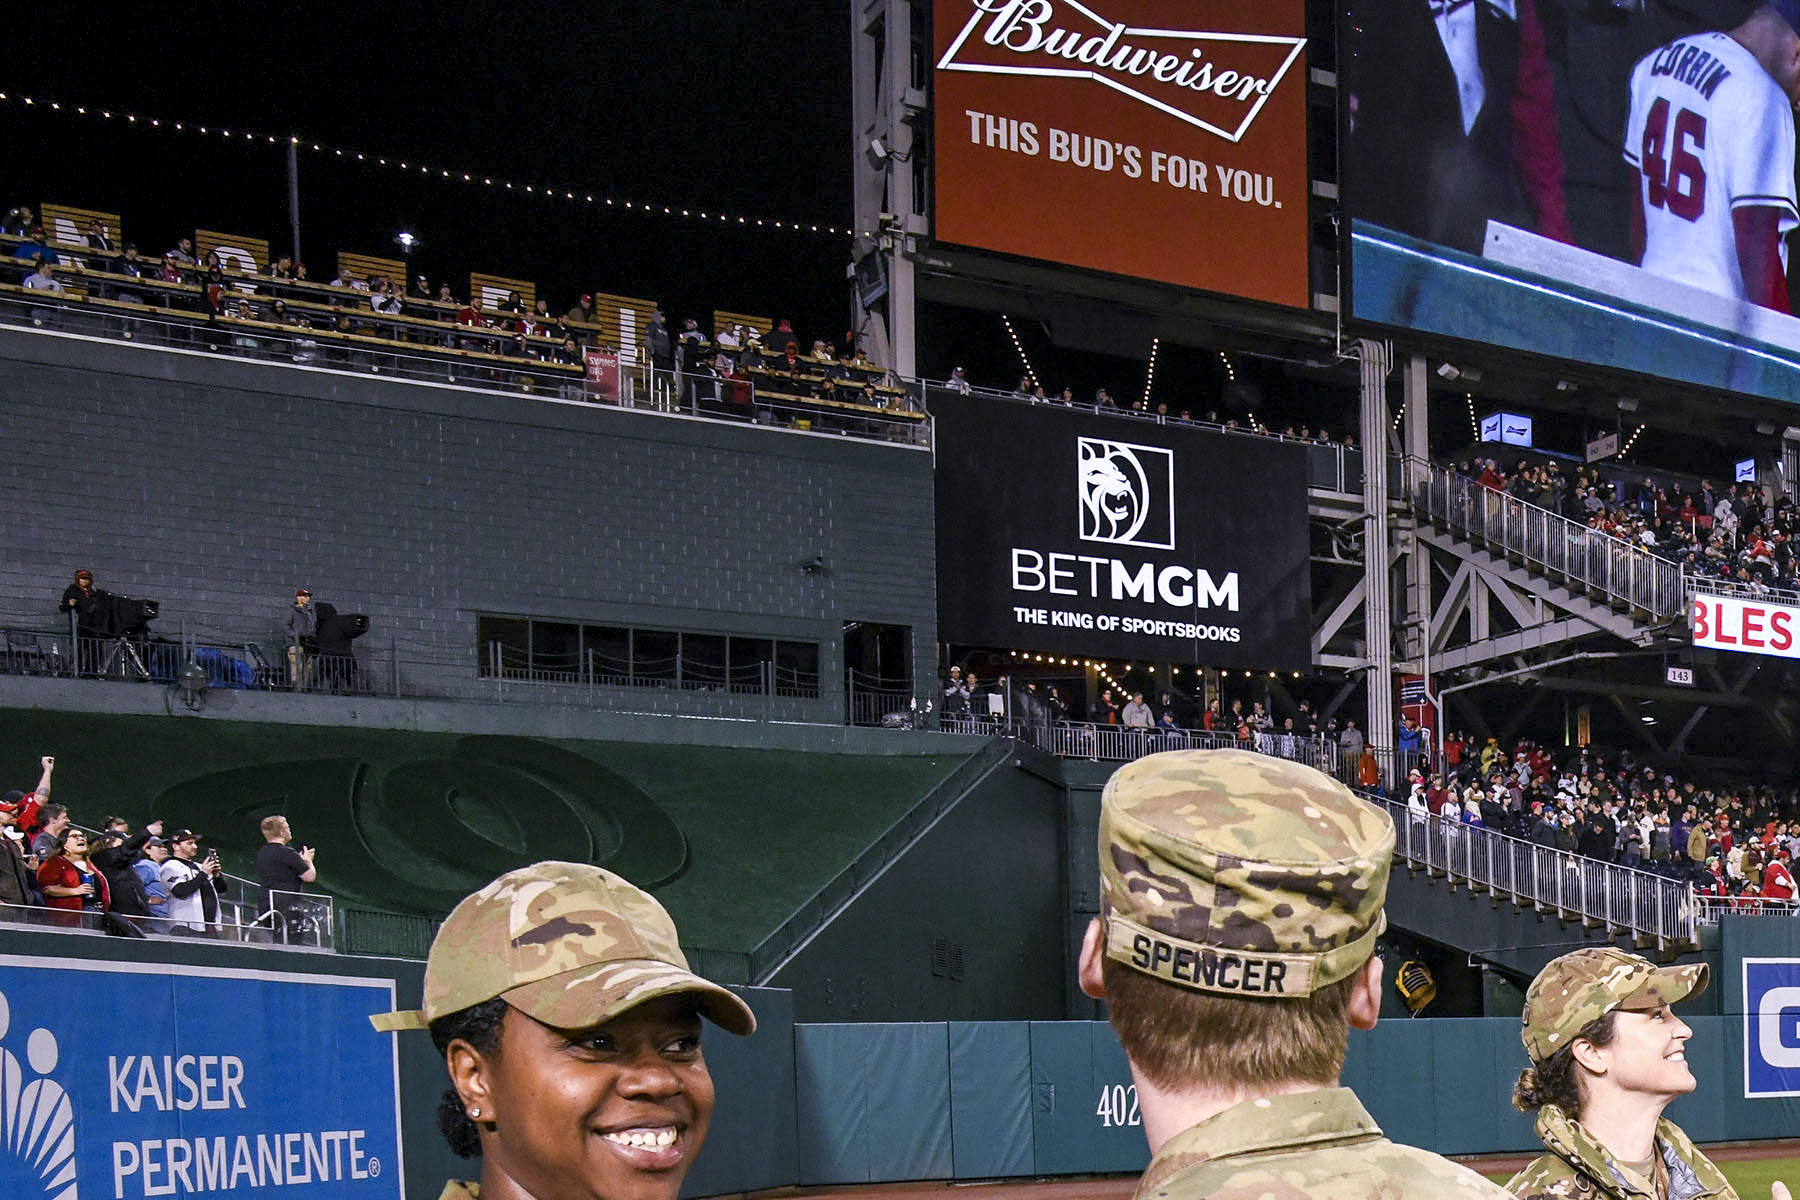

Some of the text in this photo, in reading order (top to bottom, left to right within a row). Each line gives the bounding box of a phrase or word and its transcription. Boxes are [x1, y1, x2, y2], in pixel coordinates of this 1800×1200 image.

[973, 0, 1267, 101] Budweiser
[1651, 41, 1732, 101] CORBIN
[966, 110, 1040, 156] THIS
[1151, 151, 1208, 194] FOR
[1216, 165, 1283, 209] YOU.
[1642, 97, 1707, 223] 46
[1011, 548, 1240, 612] BETMGM
[1013, 606, 1241, 643] THE KING OF SPORTSBOOKS
[1672, 670, 1689, 682] 143
[1132, 934, 1287, 993] SPENCER
[109, 1055, 247, 1113] KAISER
[1096, 1084, 1141, 1127] 402
